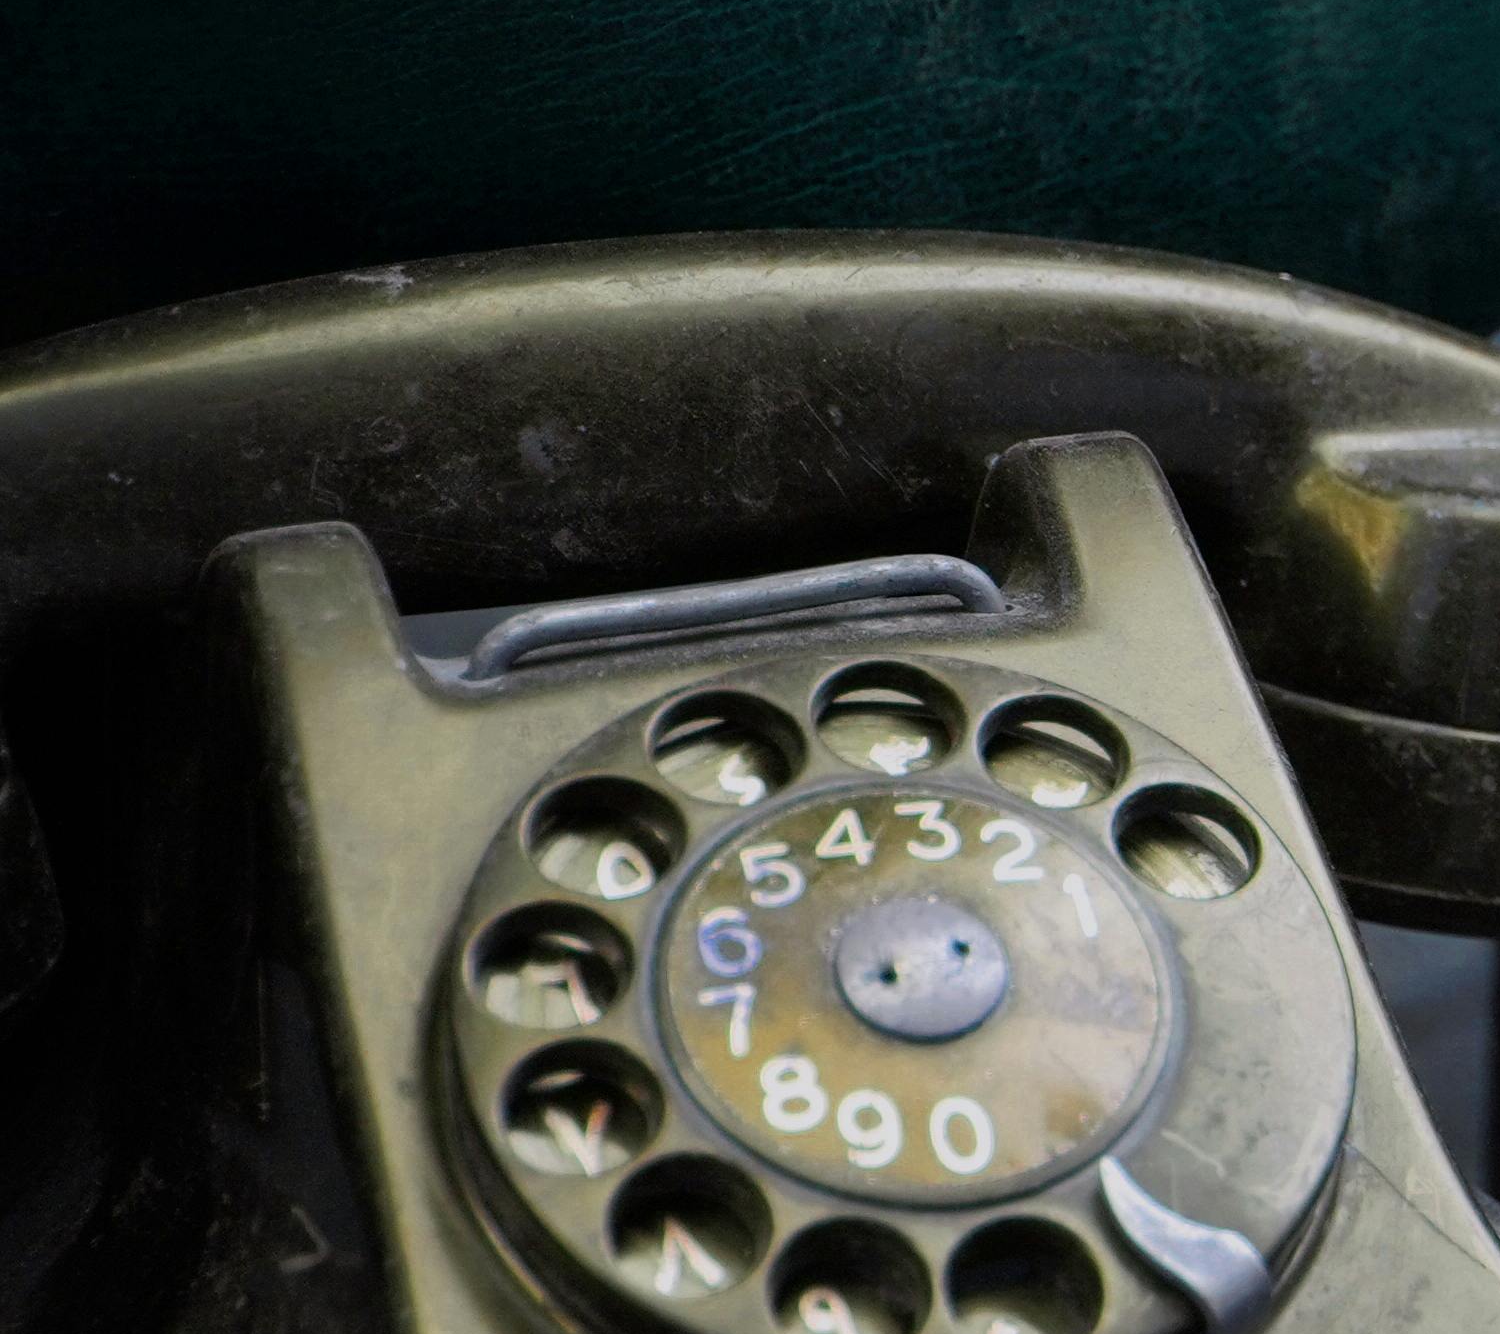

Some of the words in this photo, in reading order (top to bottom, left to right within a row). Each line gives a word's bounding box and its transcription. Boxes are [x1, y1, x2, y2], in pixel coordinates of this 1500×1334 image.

[814, 807, 876, 866] 4
[894, 799, 962, 862] 3
[979, 818, 1045, 882] 2
[739, 841, 806, 908] 5
[1061, 872, 1099, 937] 1
[698, 905, 763, 978] 6
[698, 981, 756, 1059] 7
[759, 1053, 829, 1132] 8
[836, 1088, 902, 1168] 9
[928, 1095, 995, 1175] 0
